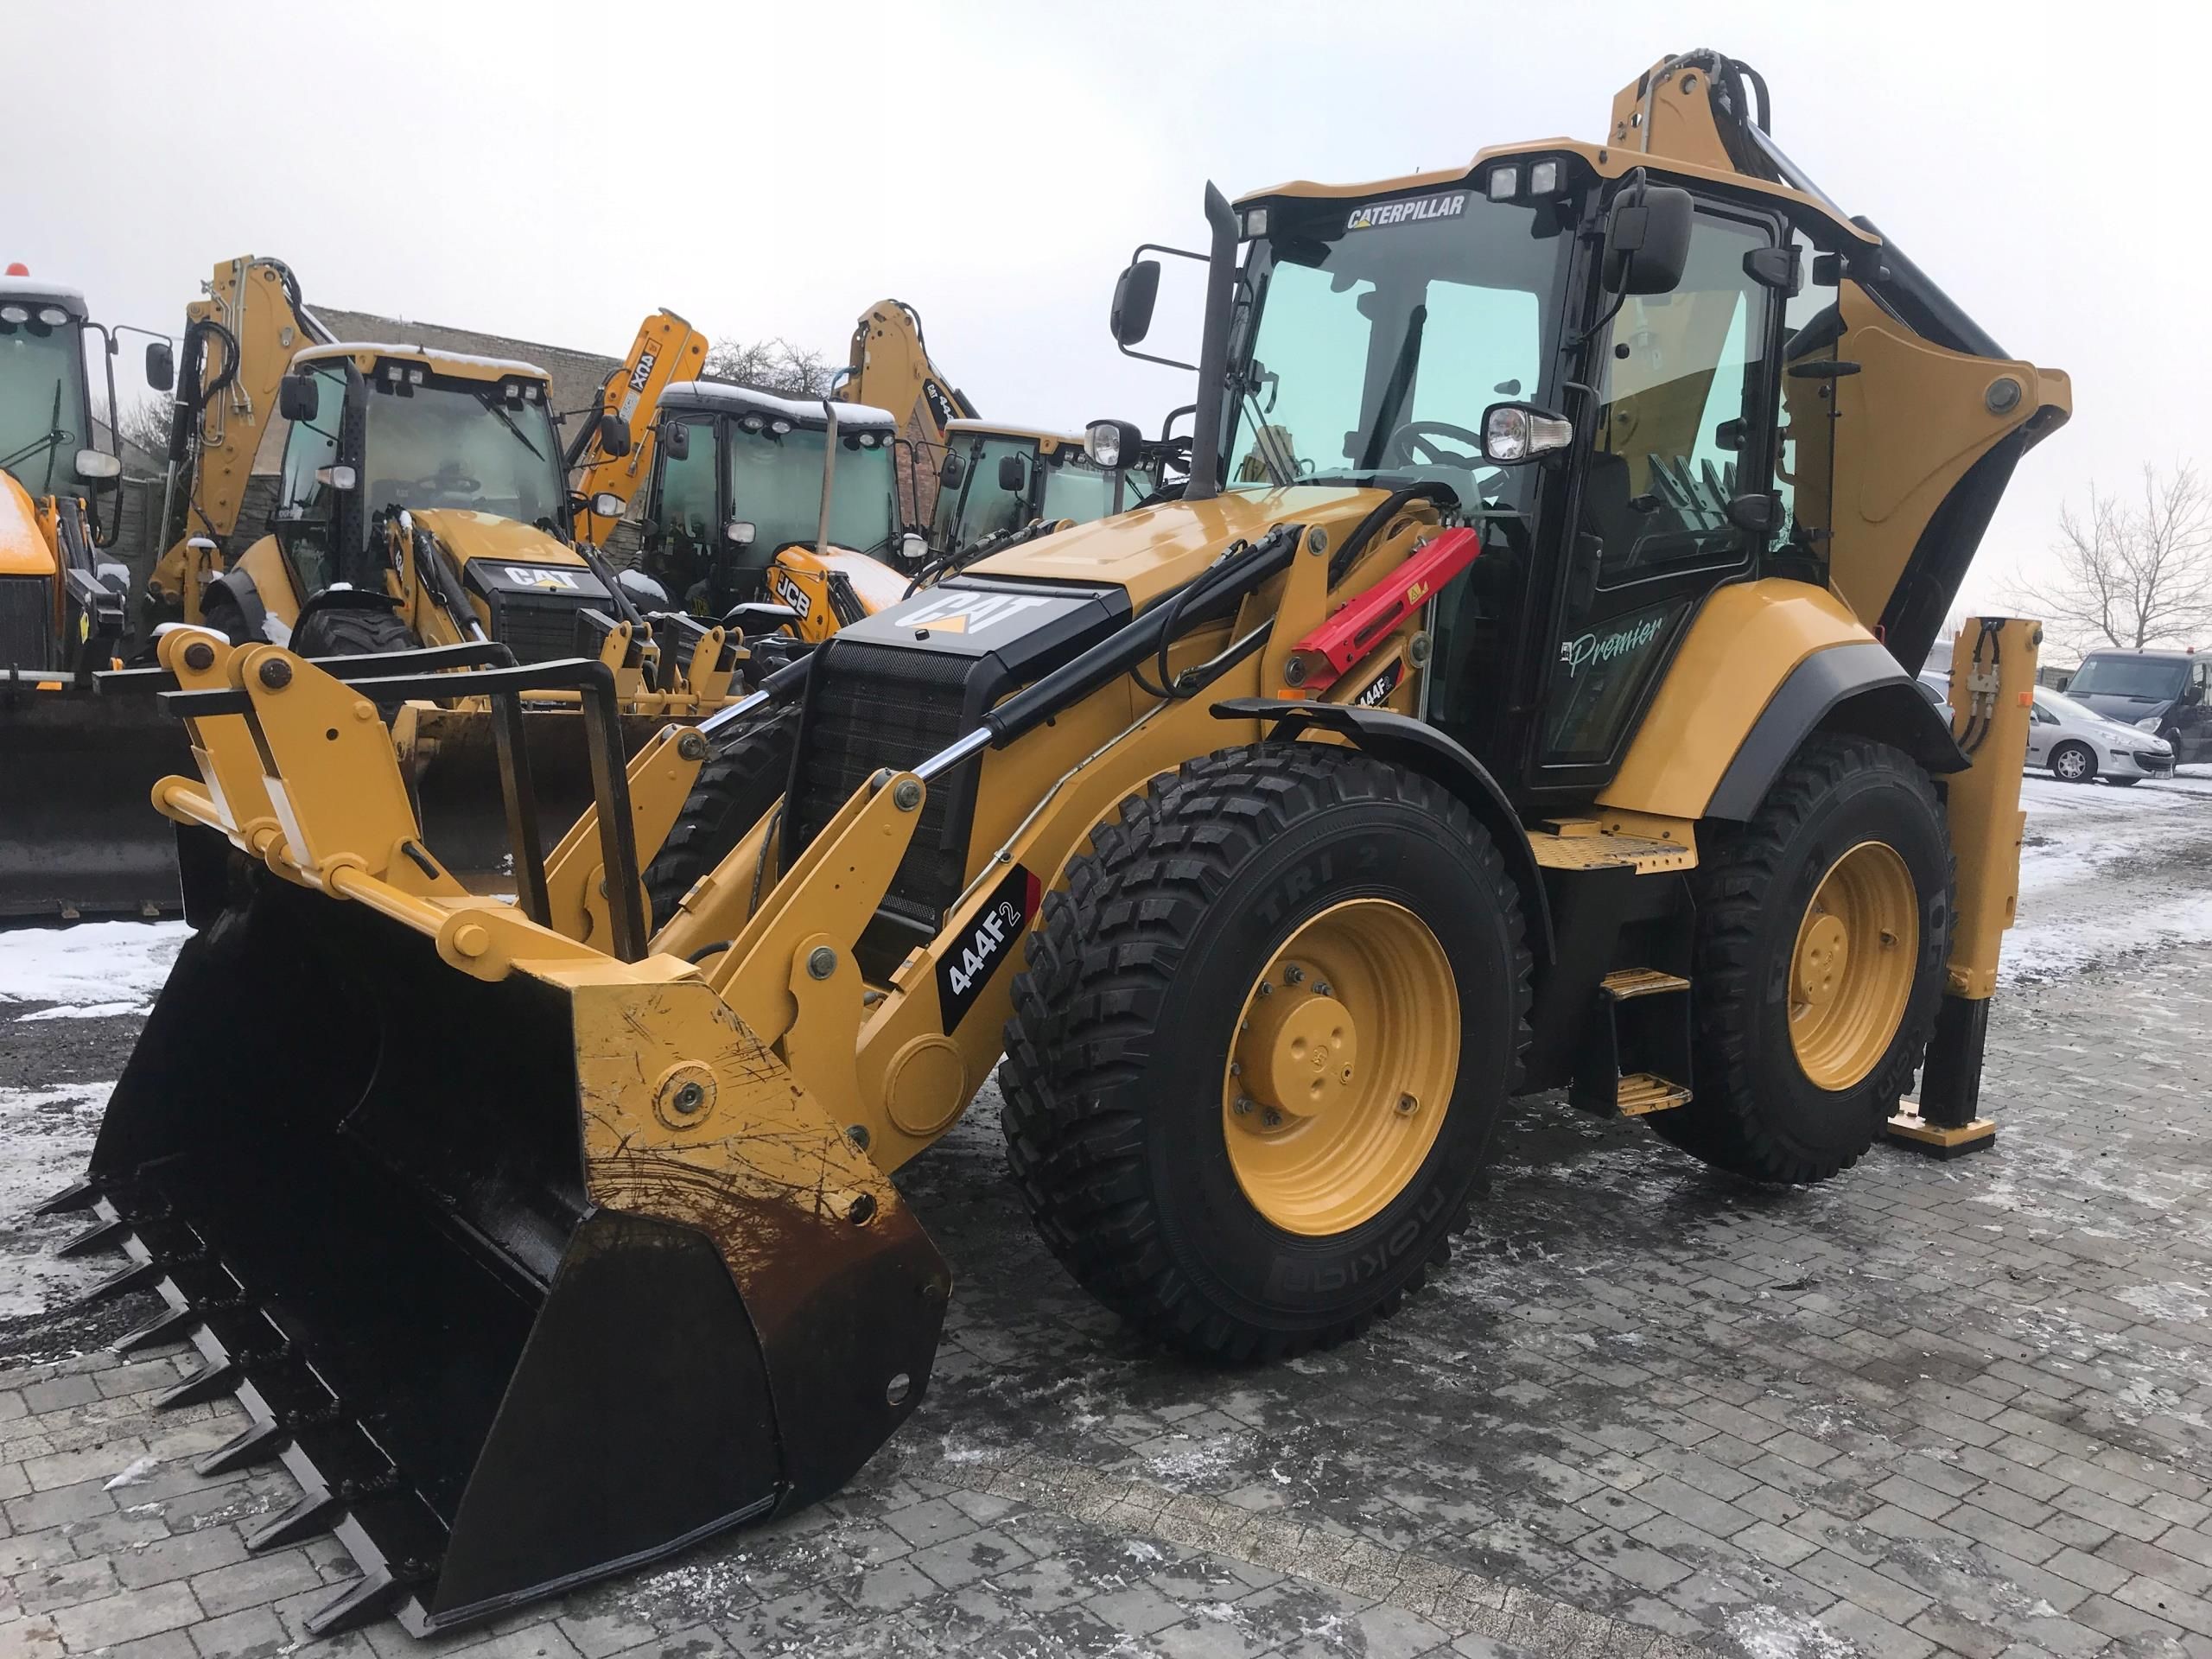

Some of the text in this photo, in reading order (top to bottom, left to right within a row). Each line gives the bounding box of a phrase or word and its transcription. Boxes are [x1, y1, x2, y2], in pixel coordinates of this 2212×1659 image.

[1347, 195, 1465, 229] CATERPILLAR
[926, 384, 938, 398] CAT
[505, 567, 580, 589] CAT
[778, 577, 810, 618] JCB
[894, 592, 1053, 635] CAT
[1568, 617, 1663, 678] Premier
